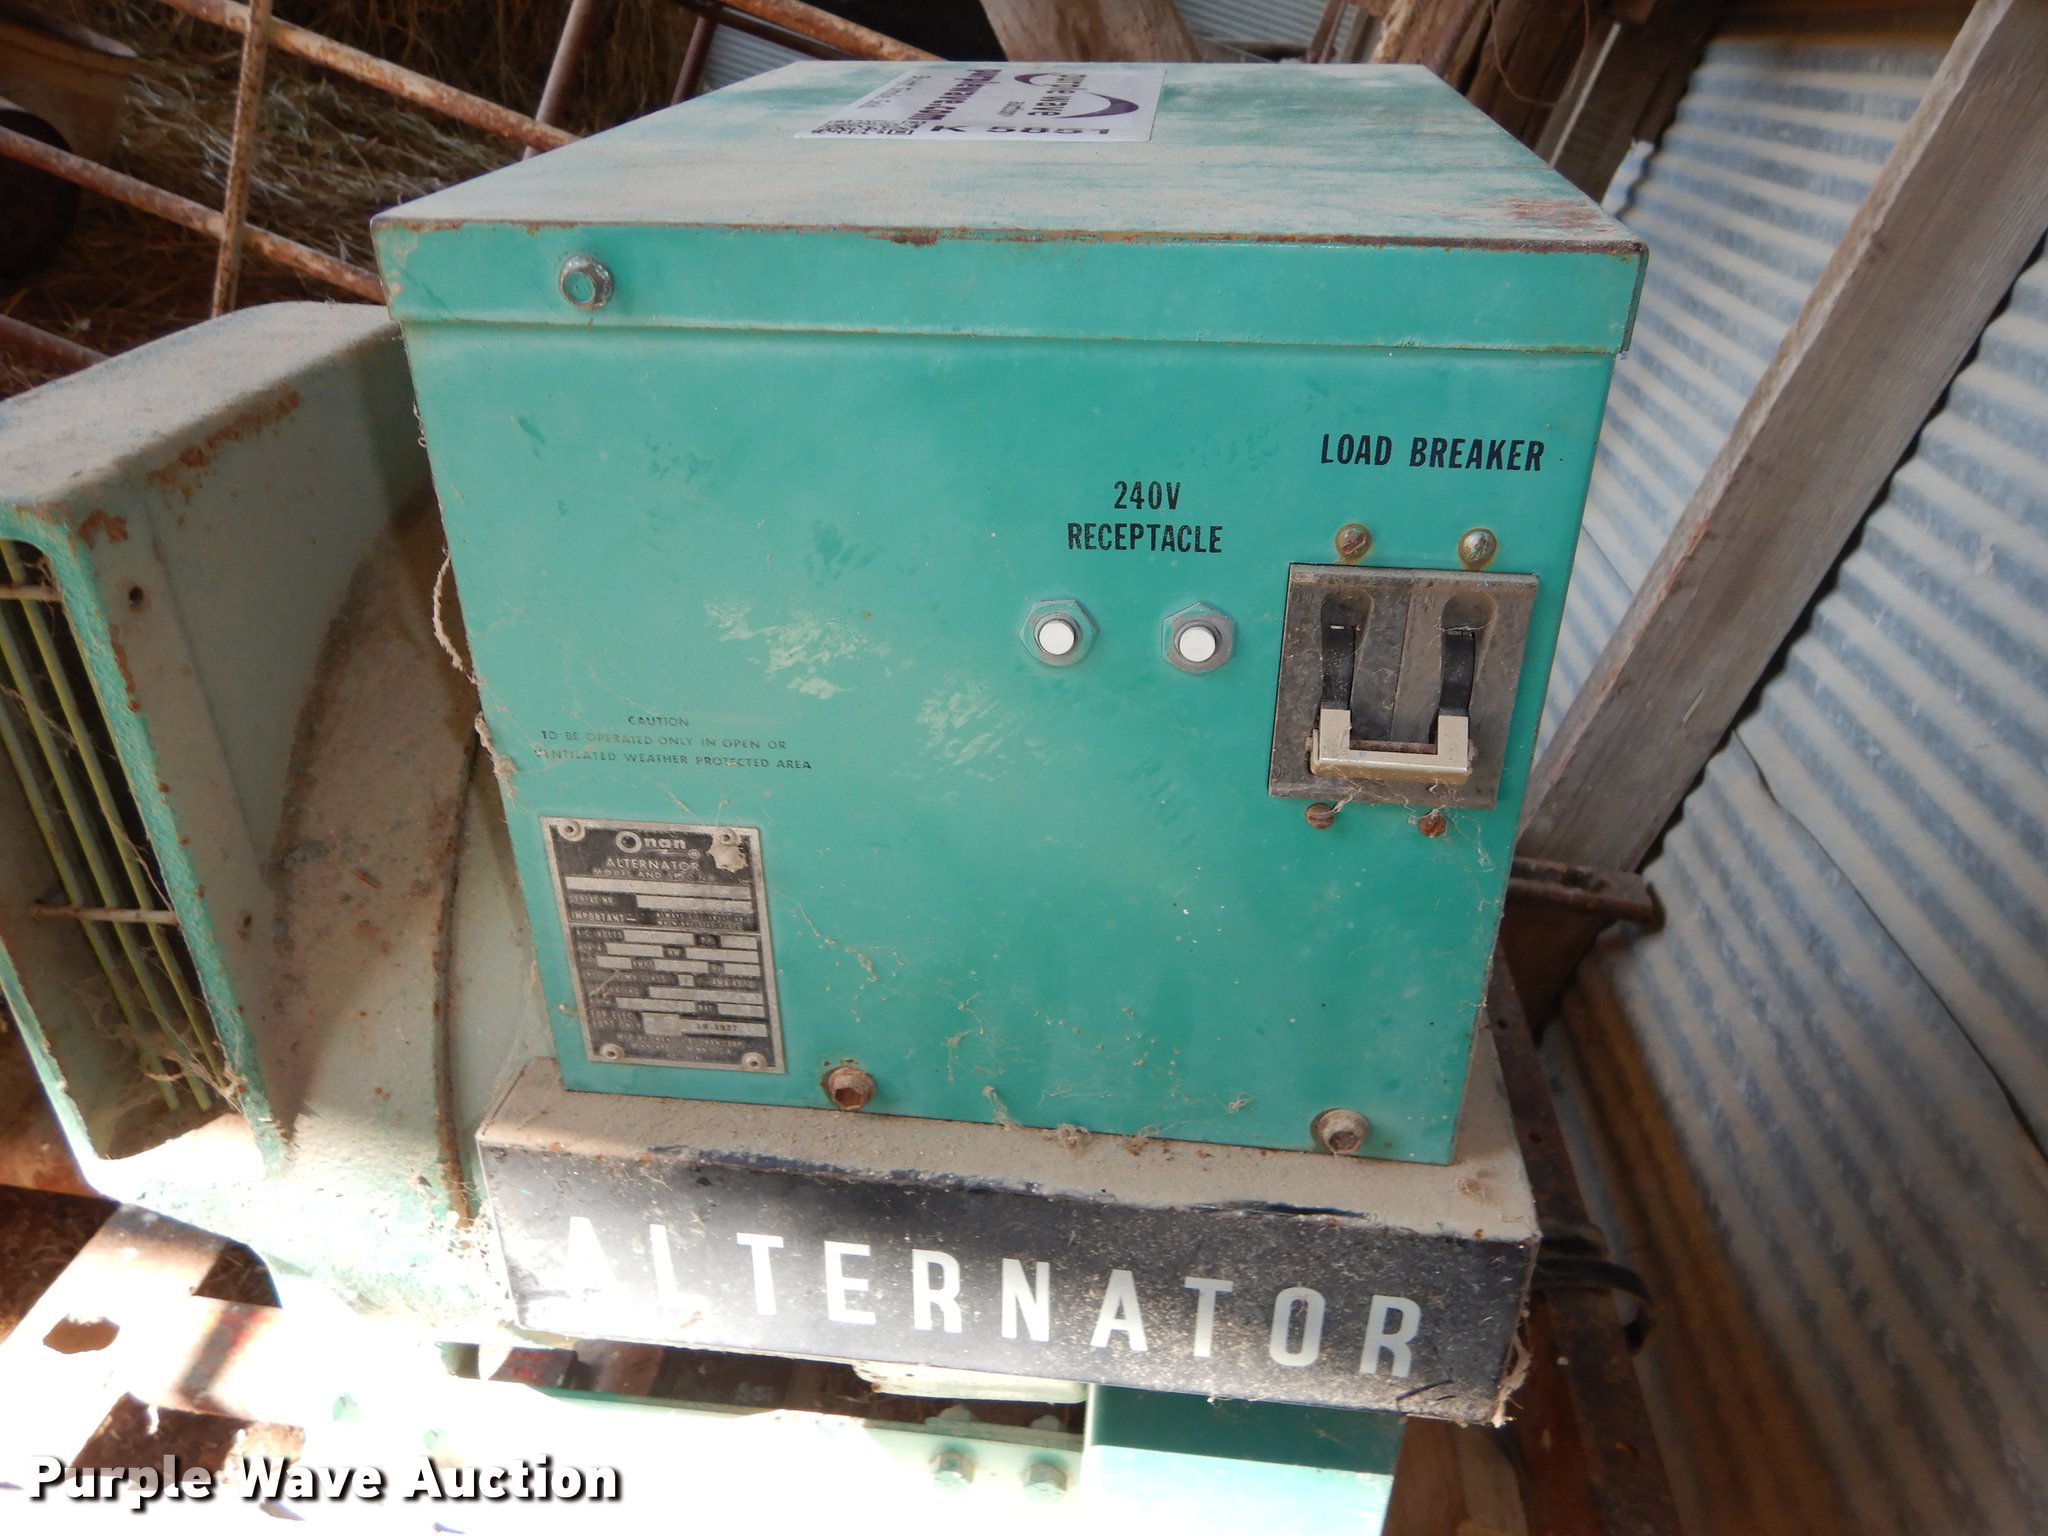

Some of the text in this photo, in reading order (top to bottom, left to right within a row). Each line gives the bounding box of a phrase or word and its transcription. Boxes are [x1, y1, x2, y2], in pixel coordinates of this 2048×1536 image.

[1028, 96, 1073, 116] wave
[1320, 433, 1545, 472] LOAD BREAKER
[1113, 480, 1182, 510] 240V
[1066, 522, 1224, 554] RECEPTACLE
[627, 715, 689, 727] CAUTION
[541, 730, 787, 751] TO BE OPERATED ONLY IN OPEN OR
[534, 748, 812, 770] VENTILATED WEATHER PROTECTED AREA
[614, 829, 687, 854] Onan
[605, 857, 701, 873] ALTERNATOR
[638, 870, 661, 879] AND
[562, 1216, 1423, 1380] ALTERNATOR
